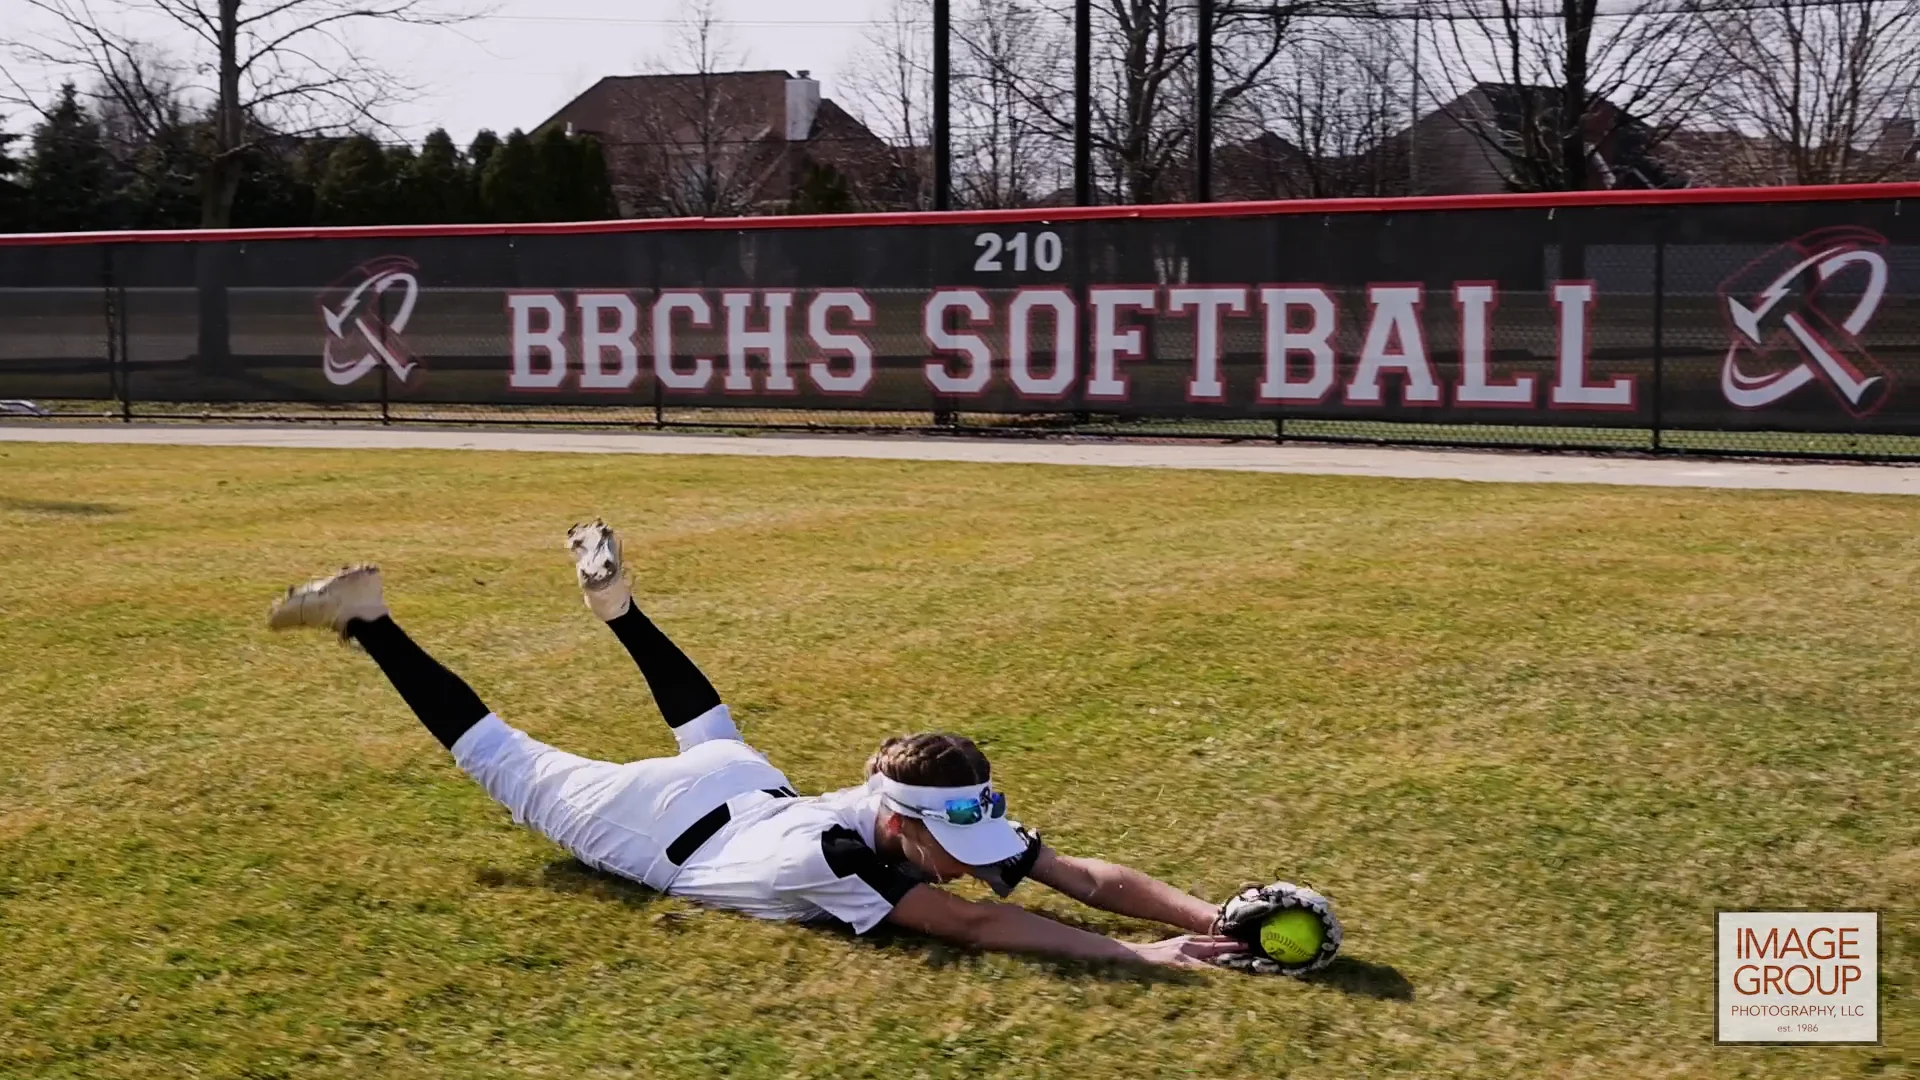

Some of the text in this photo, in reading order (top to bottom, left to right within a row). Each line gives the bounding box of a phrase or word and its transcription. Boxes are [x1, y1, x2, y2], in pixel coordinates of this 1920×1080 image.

[973, 231, 1063, 272] 210
[507, 283, 1635, 408] BBCHS SOFTBALL
